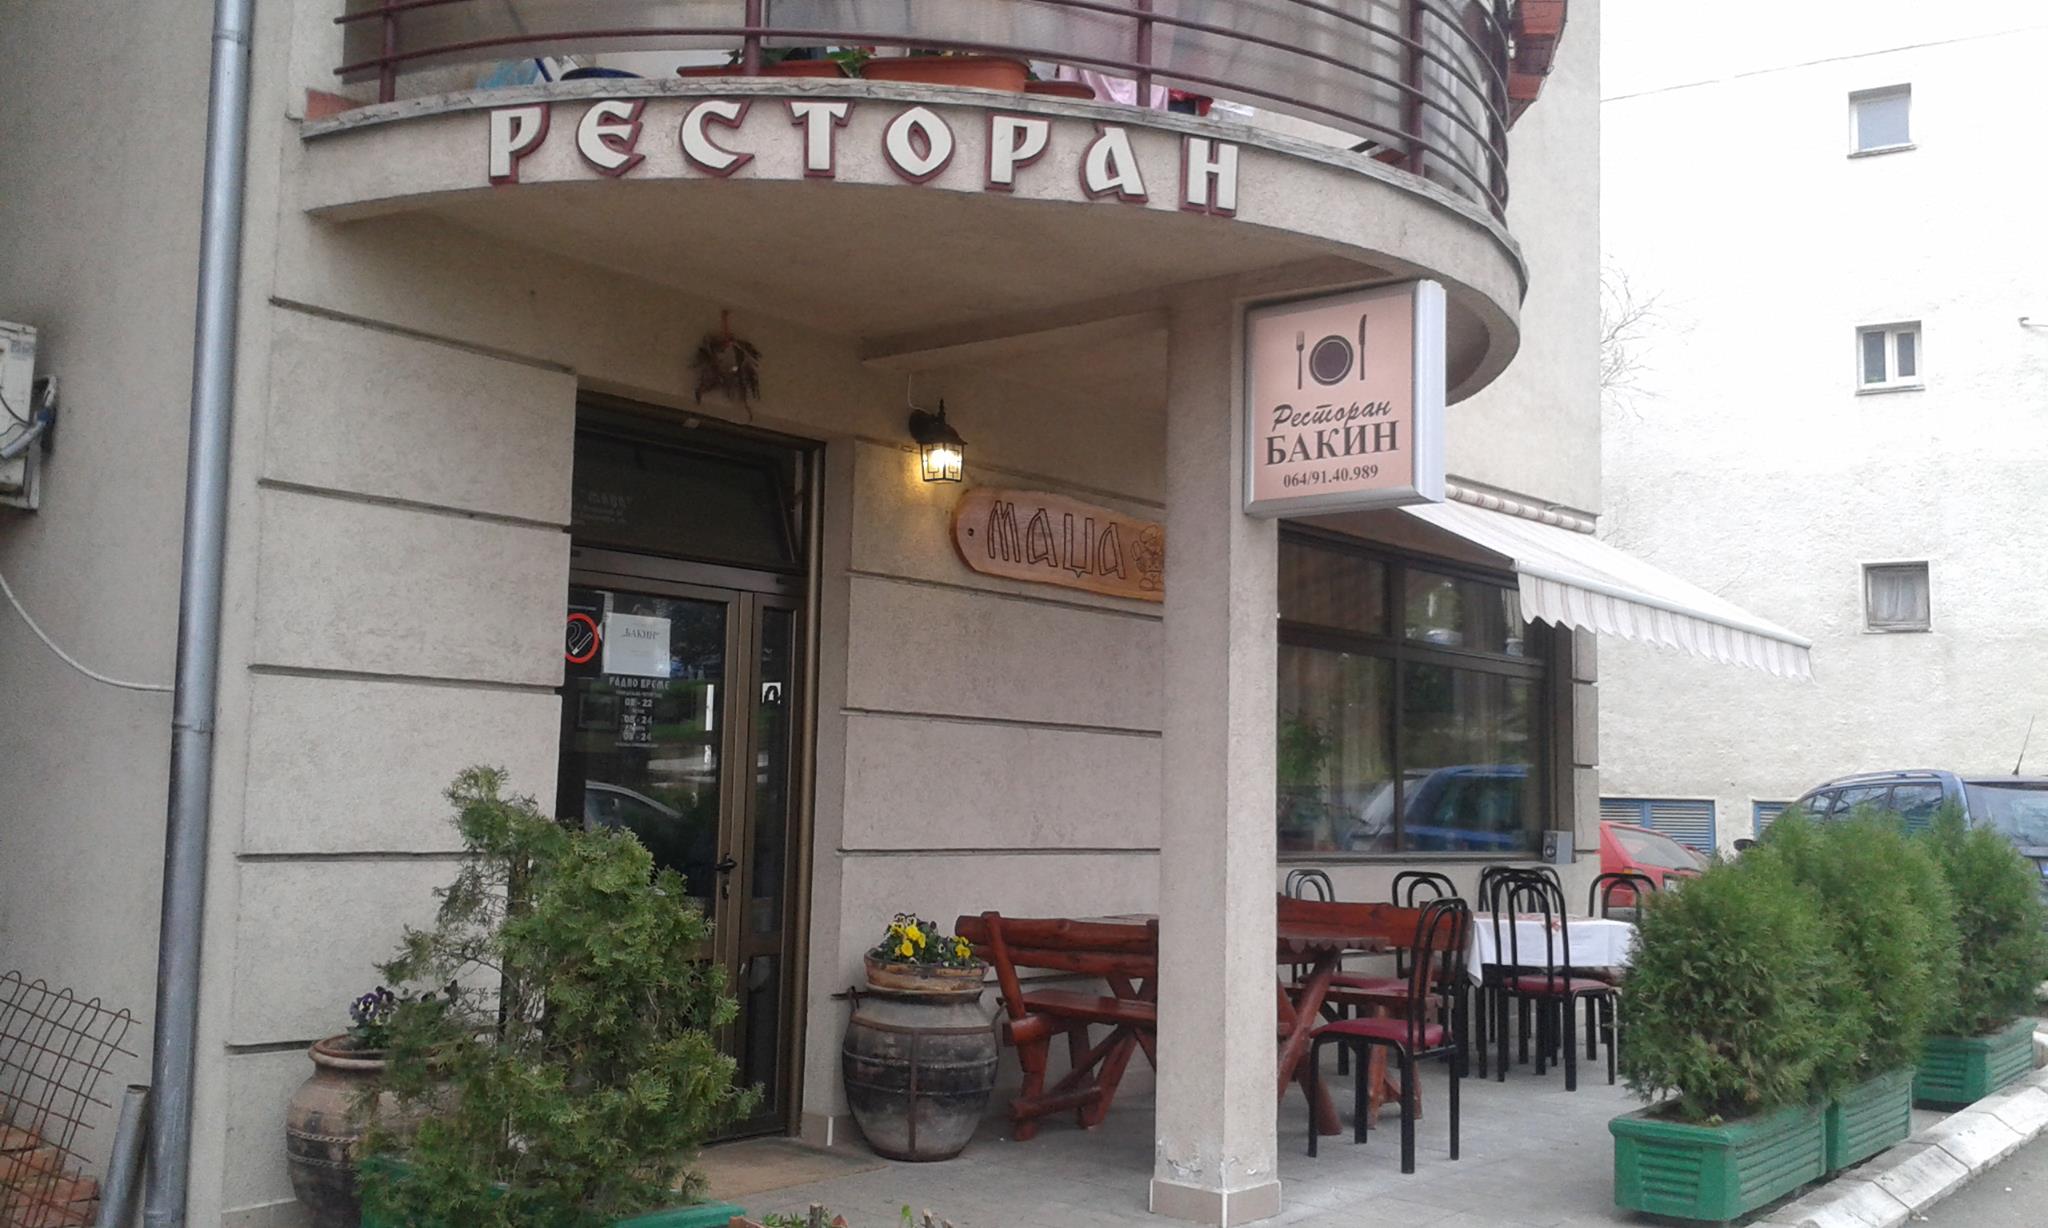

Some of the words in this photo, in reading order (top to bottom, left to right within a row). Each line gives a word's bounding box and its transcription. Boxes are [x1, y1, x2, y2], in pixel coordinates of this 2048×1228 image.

[488, 99, 1240, 217] РЕСТОРАН
[1272, 401, 1392, 431] Ресторан
[1265, 420, 1400, 465] БАКИН
[1283, 464, 1379, 488] 064/91.40.989
